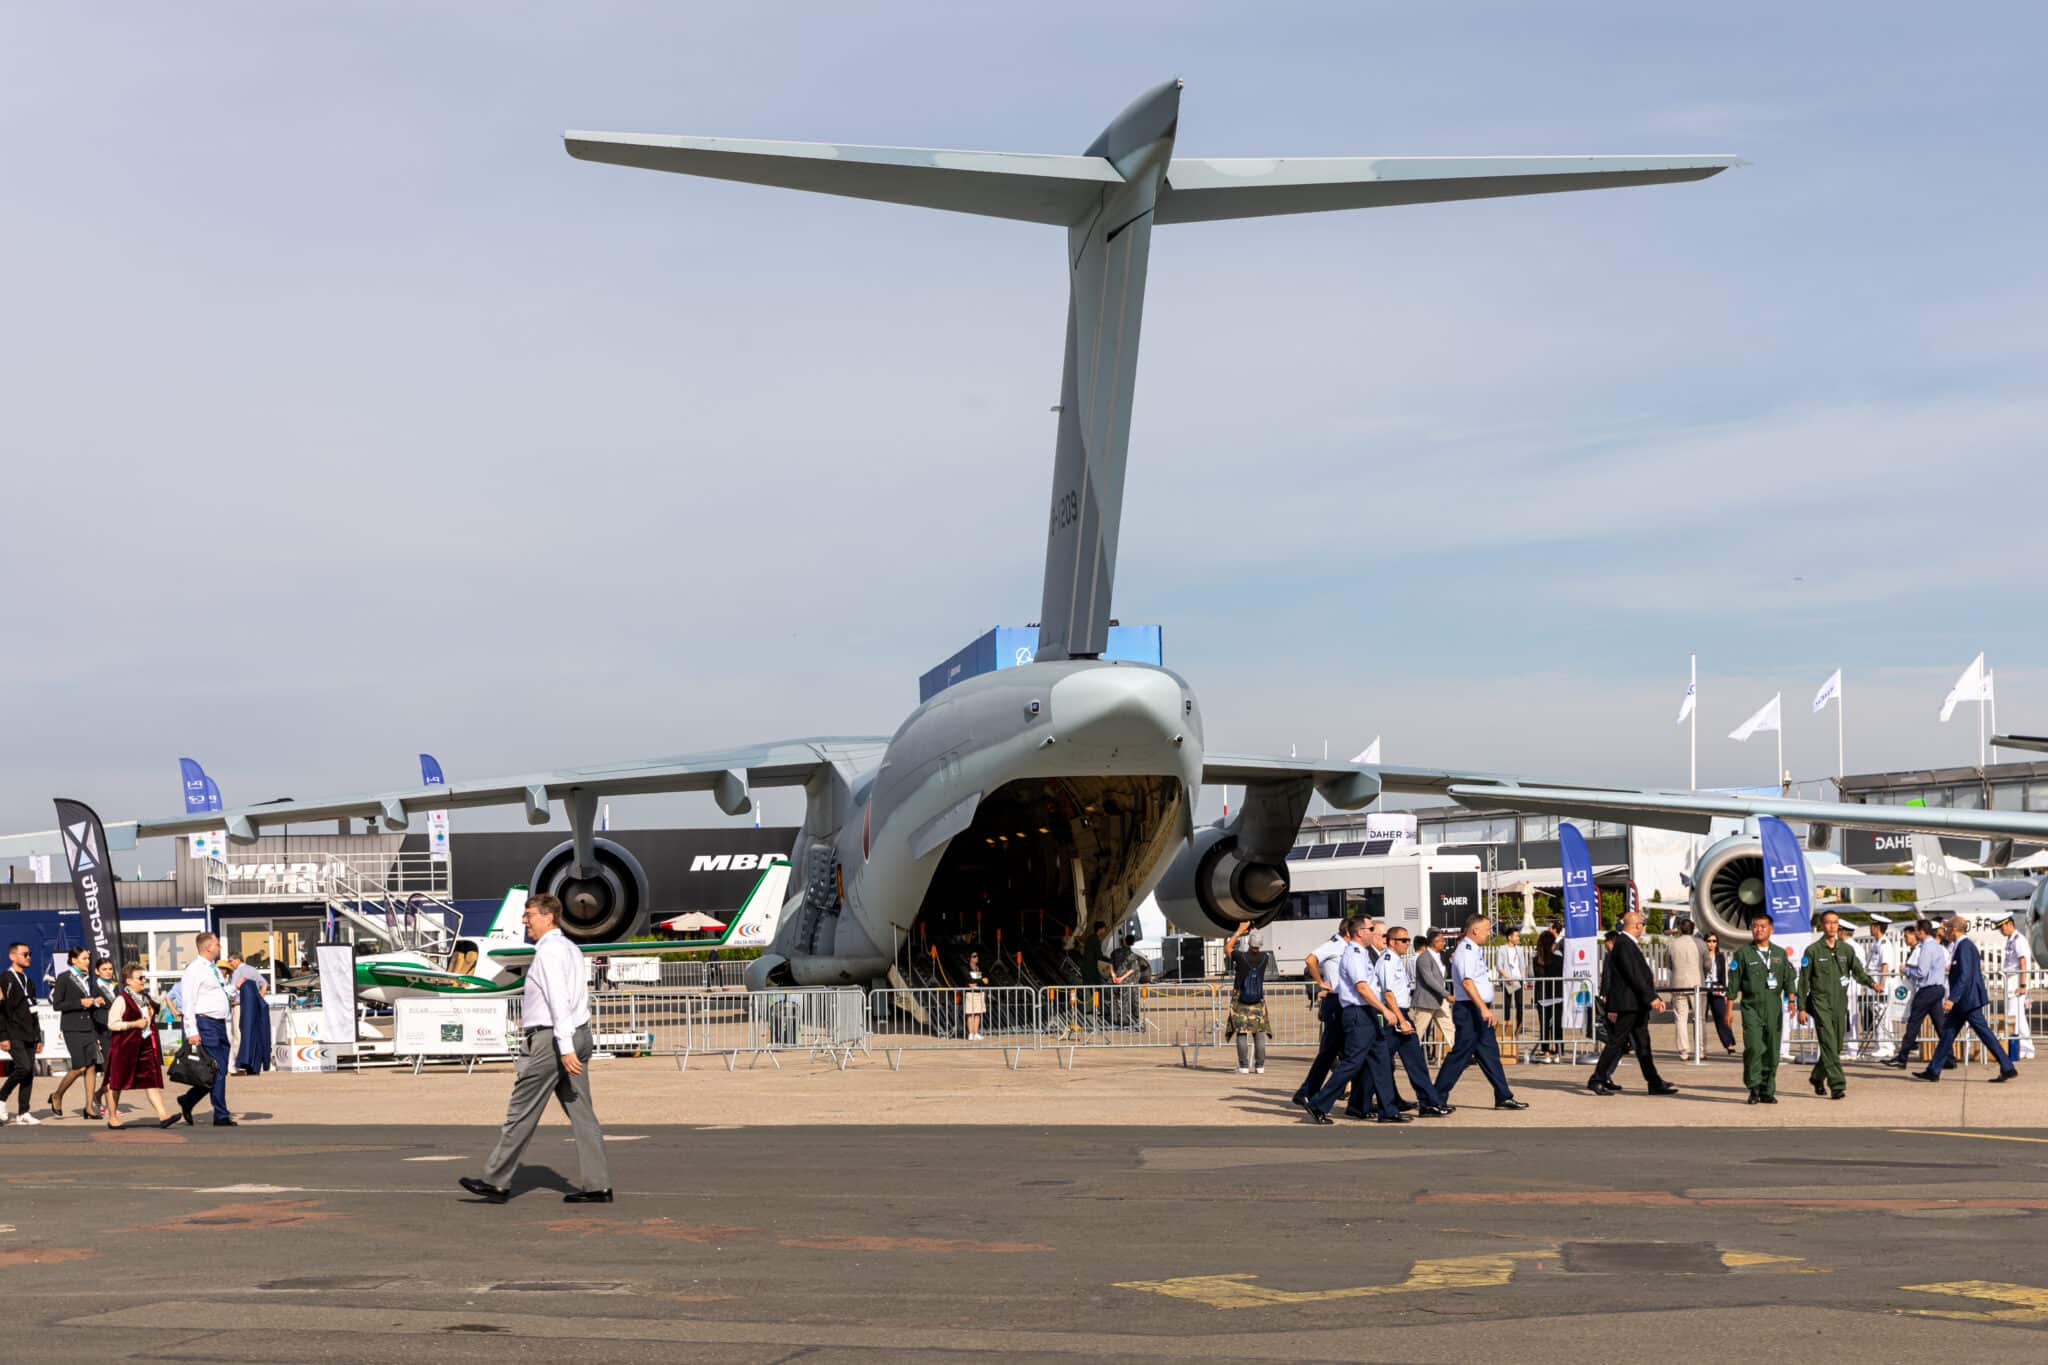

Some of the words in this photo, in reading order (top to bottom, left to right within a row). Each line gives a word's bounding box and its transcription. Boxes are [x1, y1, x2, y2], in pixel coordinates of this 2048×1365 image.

[1369, 830, 1403, 839] DAHER
[1875, 836, 1912, 850] DAHE
[1443, 897, 1468, 906] DAHER
